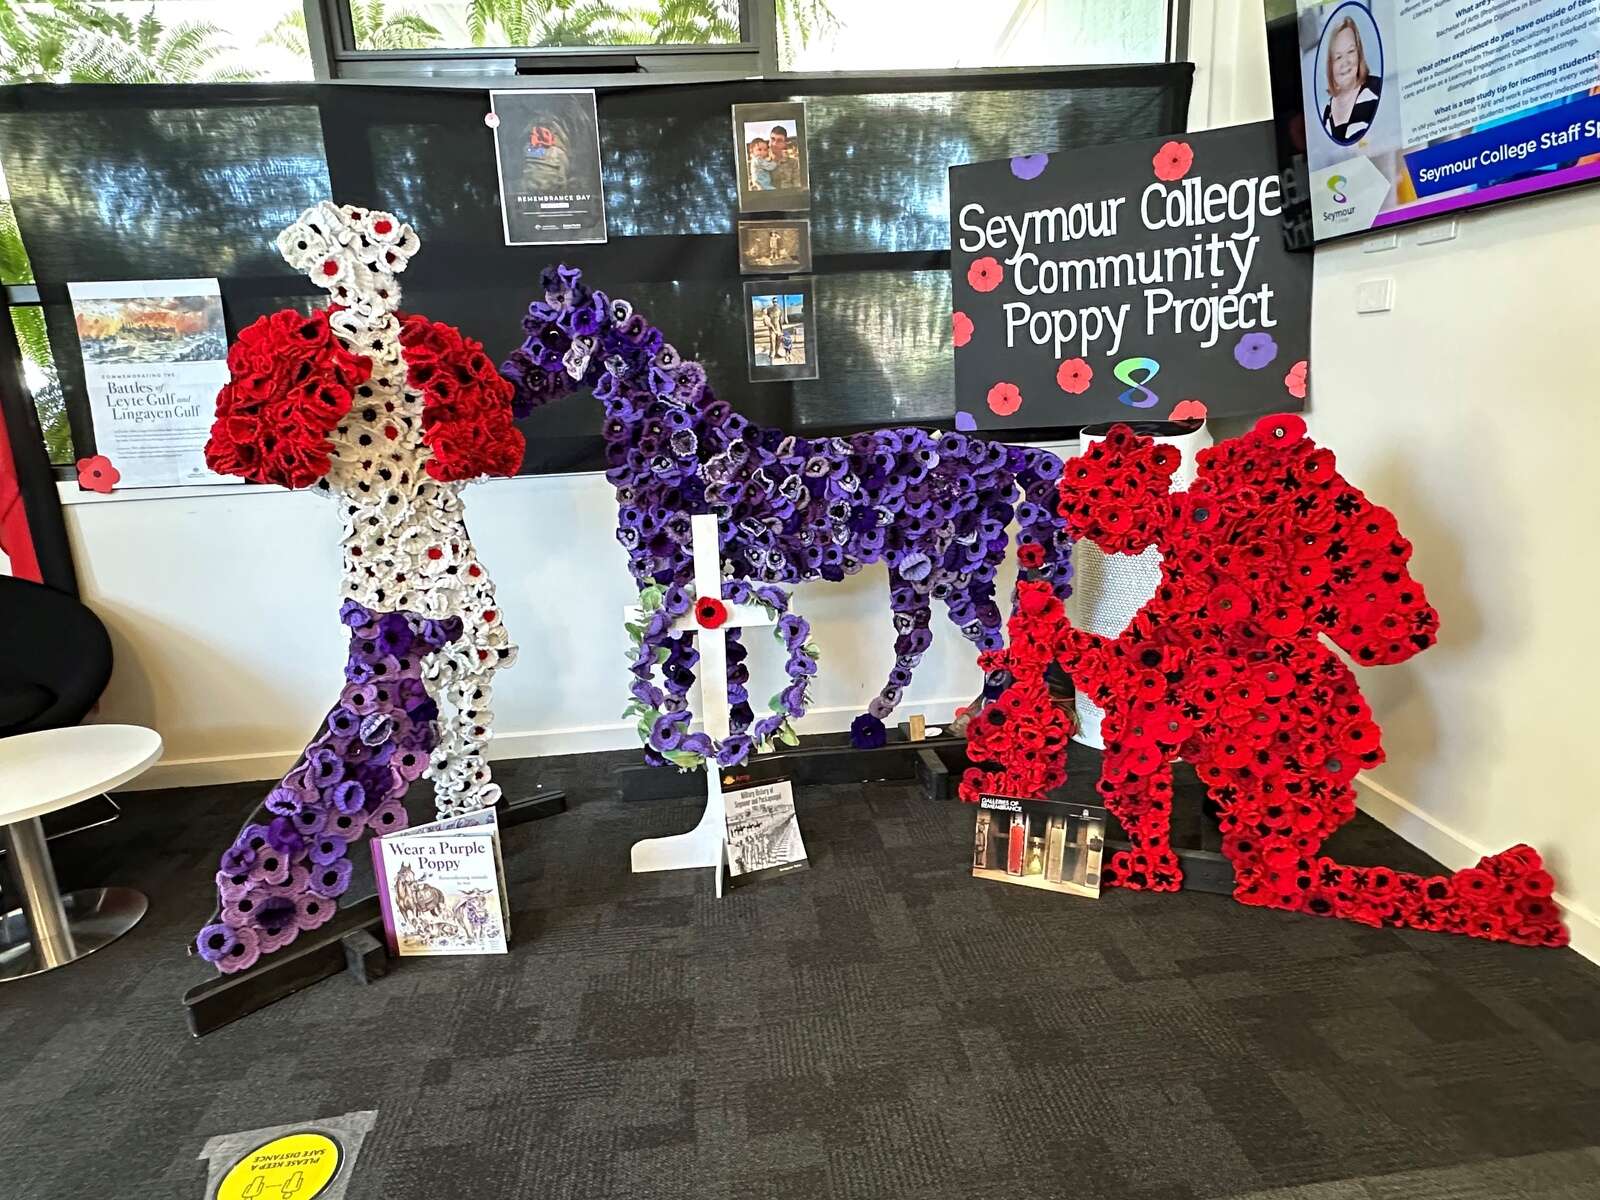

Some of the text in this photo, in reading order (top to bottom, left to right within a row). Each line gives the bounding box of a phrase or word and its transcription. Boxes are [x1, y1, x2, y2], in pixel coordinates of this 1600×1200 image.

[1455, 5, 1474, 18] What
[1436, 23, 1459, 38] Bachelor
[1460, 18, 1467, 26] of
[1454, 30, 1465, 39] and
[1466, 19, 1492, 34] Graduate
[1493, 6, 1520, 22] Diploma
[1417, 63, 1433, 75] What
[1434, 57, 1451, 67] other
[1452, 40, 1489, 60] experience
[1490, 35, 1500, 44] do
[1501, 30, 1515, 42] you
[1516, 21, 1534, 33] have
[1535, 7, 1566, 25] outside
[1567, 0, 1576, 11] of
[1464, 54, 1481, 65] Youth
[1482, 42, 1510, 57] Therapist
[1511, 26, 1550, 46] Specializing
[1551, 22, 1558, 30] in
[1560, 7, 1596, 26] Education
[1448, 69, 1472, 82] Learning
[1473, 53, 1511, 72] Engagement
[1512, 44, 1532, 56] Coach
[1533, 35, 1554, 48] where
[1560, 21, 1587, 37] worked
[1480, 65, 1506, 79] students
[1514, 49, 1549, 66] alternative
[1434, 104, 1451, 115] What
[1464, 96, 1475, 105] top
[1477, 88, 1495, 100] study
[1497, 84, 1507, 93] tip
[1508, 80, 1519, 89] for
[1520, 67, 1557, 85] incoming
[1437, 115, 1450, 123] need
[1477, 100, 1492, 110] TAFE
[1493, 97, 1504, 105] and
[1505, 92, 1520, 100] work
[1522, 78, 1558, 95] placement
[1559, 72, 1577, 82] every
[1479, 107, 1503, 120] students
[1505, 102, 1520, 112] need
[1540, 91, 1554, 100] very
[1419, 155, 1478, 182] Seymour
[1479, 140, 1537, 167] College
[1540, 122, 1582, 149] Staff
[958, 174, 1283, 265] Seymour College
[1323, 207, 1356, 222] Seymour
[1012, 233, 1261, 296] Community
[1003, 282, 1279, 360] Poppy Project
[107, 381, 165, 394] Battles of
[106, 395, 144, 407] Leyte
[146, 392, 176, 406] Gulf
[112, 405, 200, 423] Lingayen Gulf
[981, 797, 1009, 805] GALLERIES
[981, 802, 1022, 812] REMEMBRANCE
[388, 841, 486, 857] Wear a Purple
[418, 856, 461, 872] Poppy
[254, 1148, 327, 1162] SAFE DISTANCE
[284, 1157, 319, 1168] PLEASE
[258, 1161, 284, 1170] KEEP
